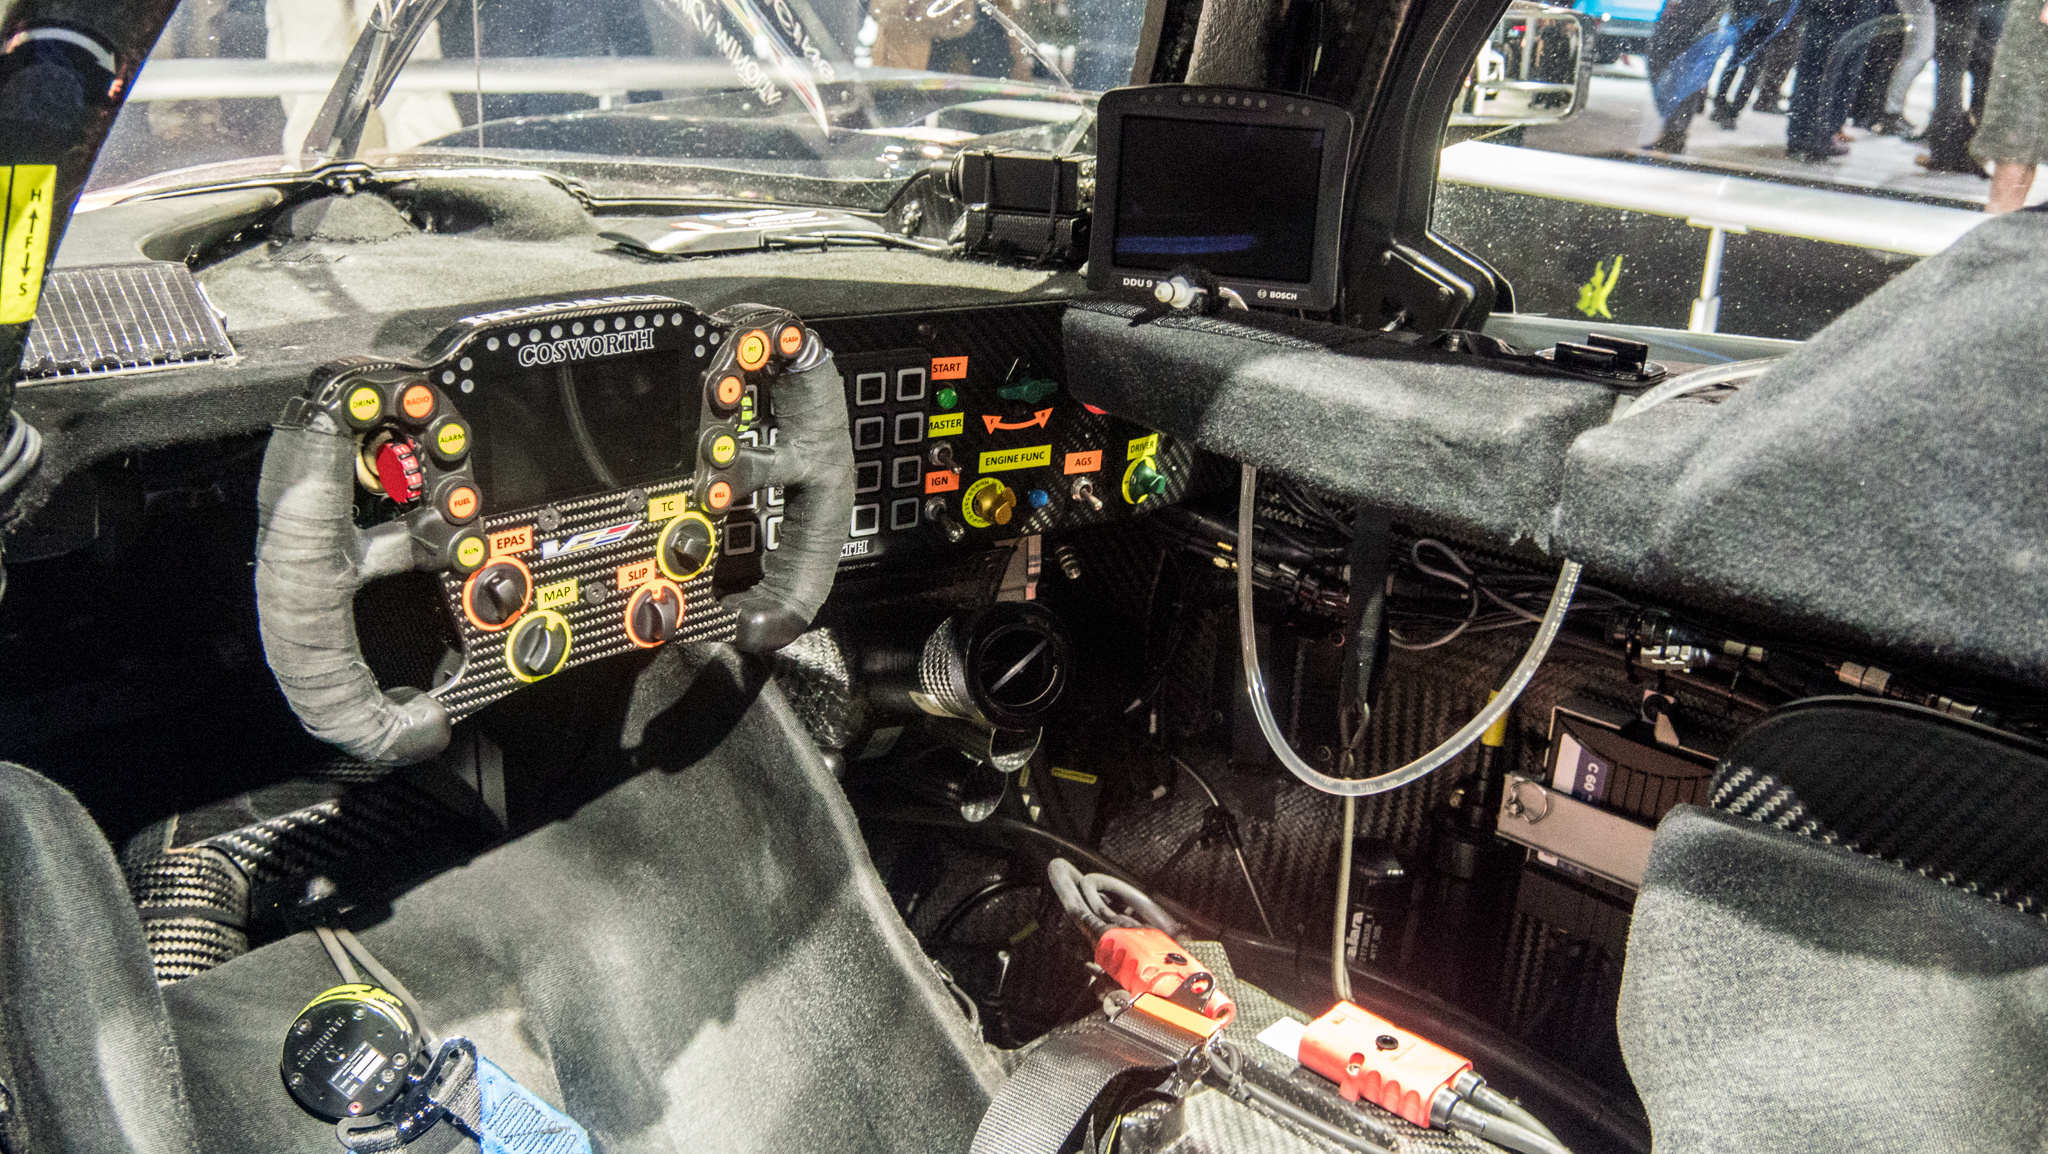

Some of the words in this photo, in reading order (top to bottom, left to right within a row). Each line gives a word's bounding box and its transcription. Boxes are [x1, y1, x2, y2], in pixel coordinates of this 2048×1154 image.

[30, 188, 42, 201] H
[25, 236, 33, 249] F
[1122, 277, 1145, 288] DDU
[1146, 279, 1153, 288] 9
[18, 282, 27, 296] S
[1269, 290, 1298, 300] BOSCH
[518, 327, 655, 367] COSWORTH
[932, 362, 962, 374] START
[353, 399, 376, 408] DRINK
[405, 396, 430, 407] RADIO
[439, 432, 465, 443] ALARM
[1130, 440, 1155, 454] DRIVER
[404, 459, 415, 468] 12
[985, 454, 1018, 467] ENGINE
[1020, 451, 1045, 463] FUNC
[1074, 457, 1092, 467] AGS
[930, 476, 948, 487] IGN
[714, 491, 725, 499] KILL
[454, 498, 471, 507] FUEL
[661, 501, 674, 513] TC
[496, 533, 526, 550] EPAS
[463, 547, 479, 556] RUN
[627, 567, 648, 582] SLIP
[543, 586, 571, 603] MAP
[1587, 762, 1599, 774] C
[1583, 774, 1597, 791] 60
